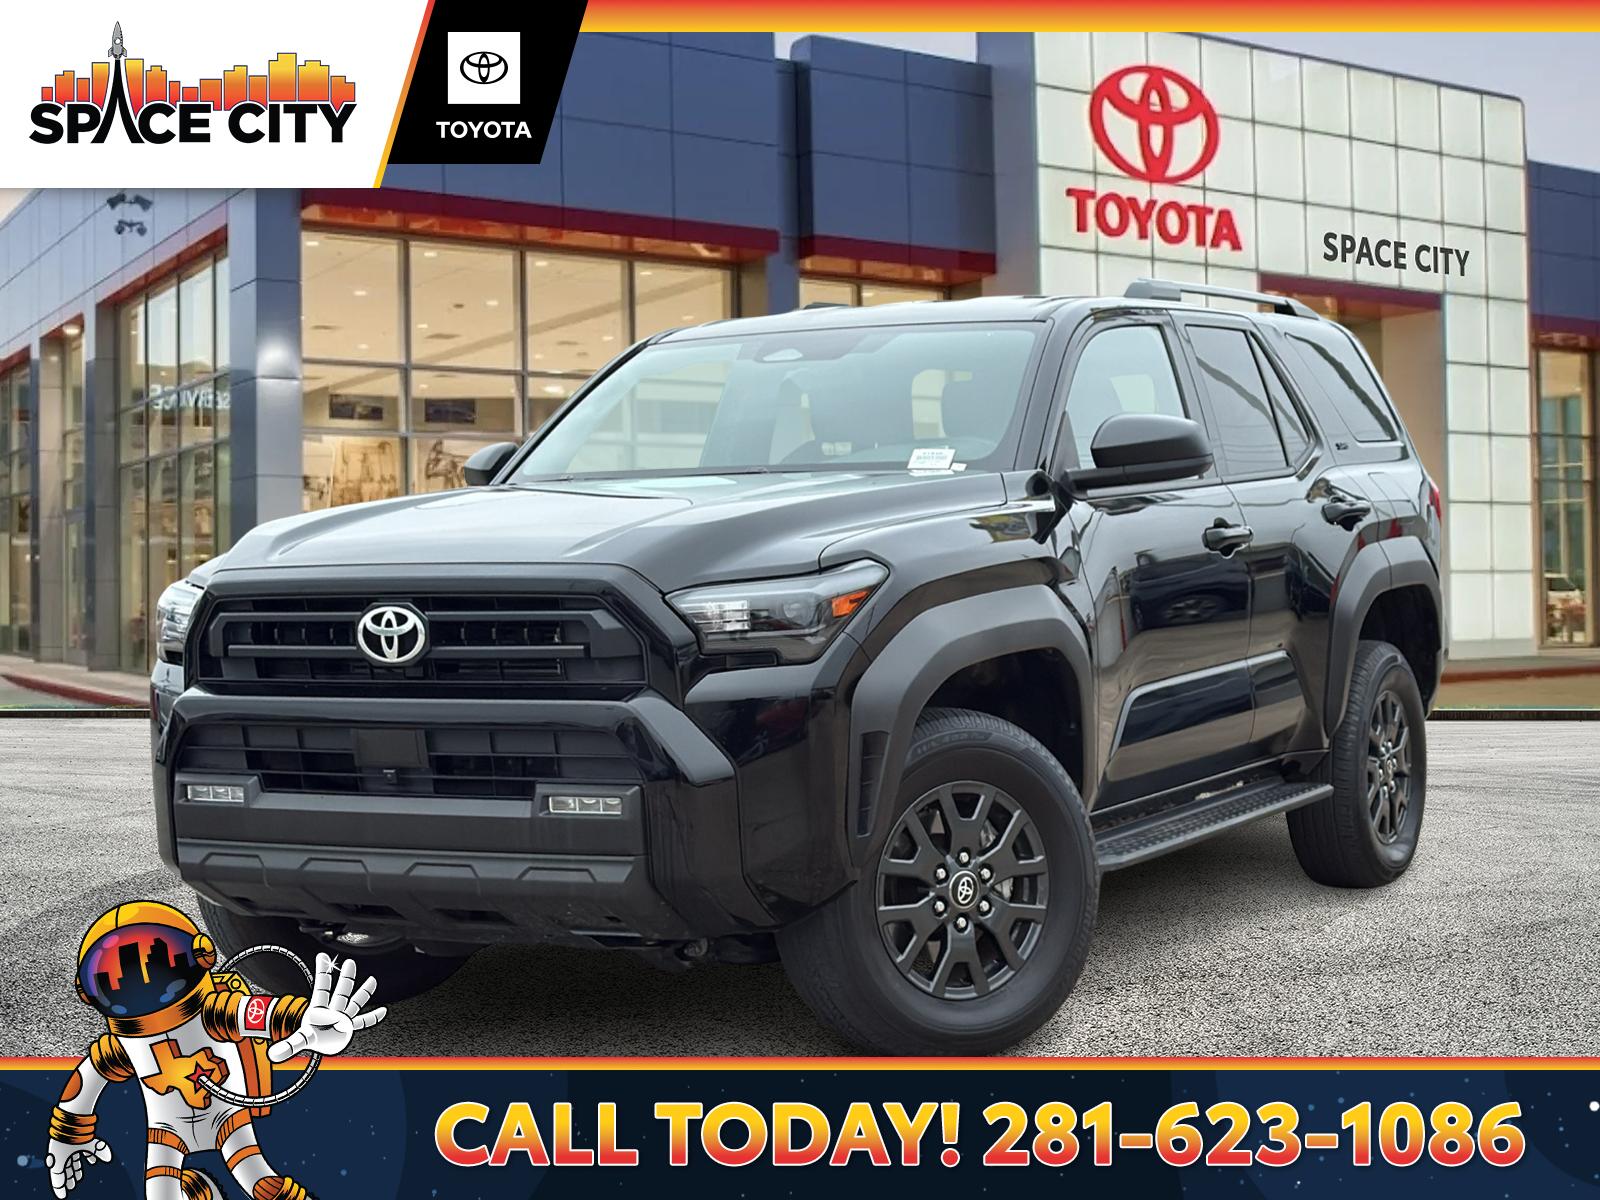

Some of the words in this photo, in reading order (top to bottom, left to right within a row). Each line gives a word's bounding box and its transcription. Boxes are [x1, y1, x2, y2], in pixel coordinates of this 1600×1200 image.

[1066, 187, 1242, 251] TOYOTA
[1323, 232, 1407, 270] SPACE
[1414, 244, 1470, 277] CITY
